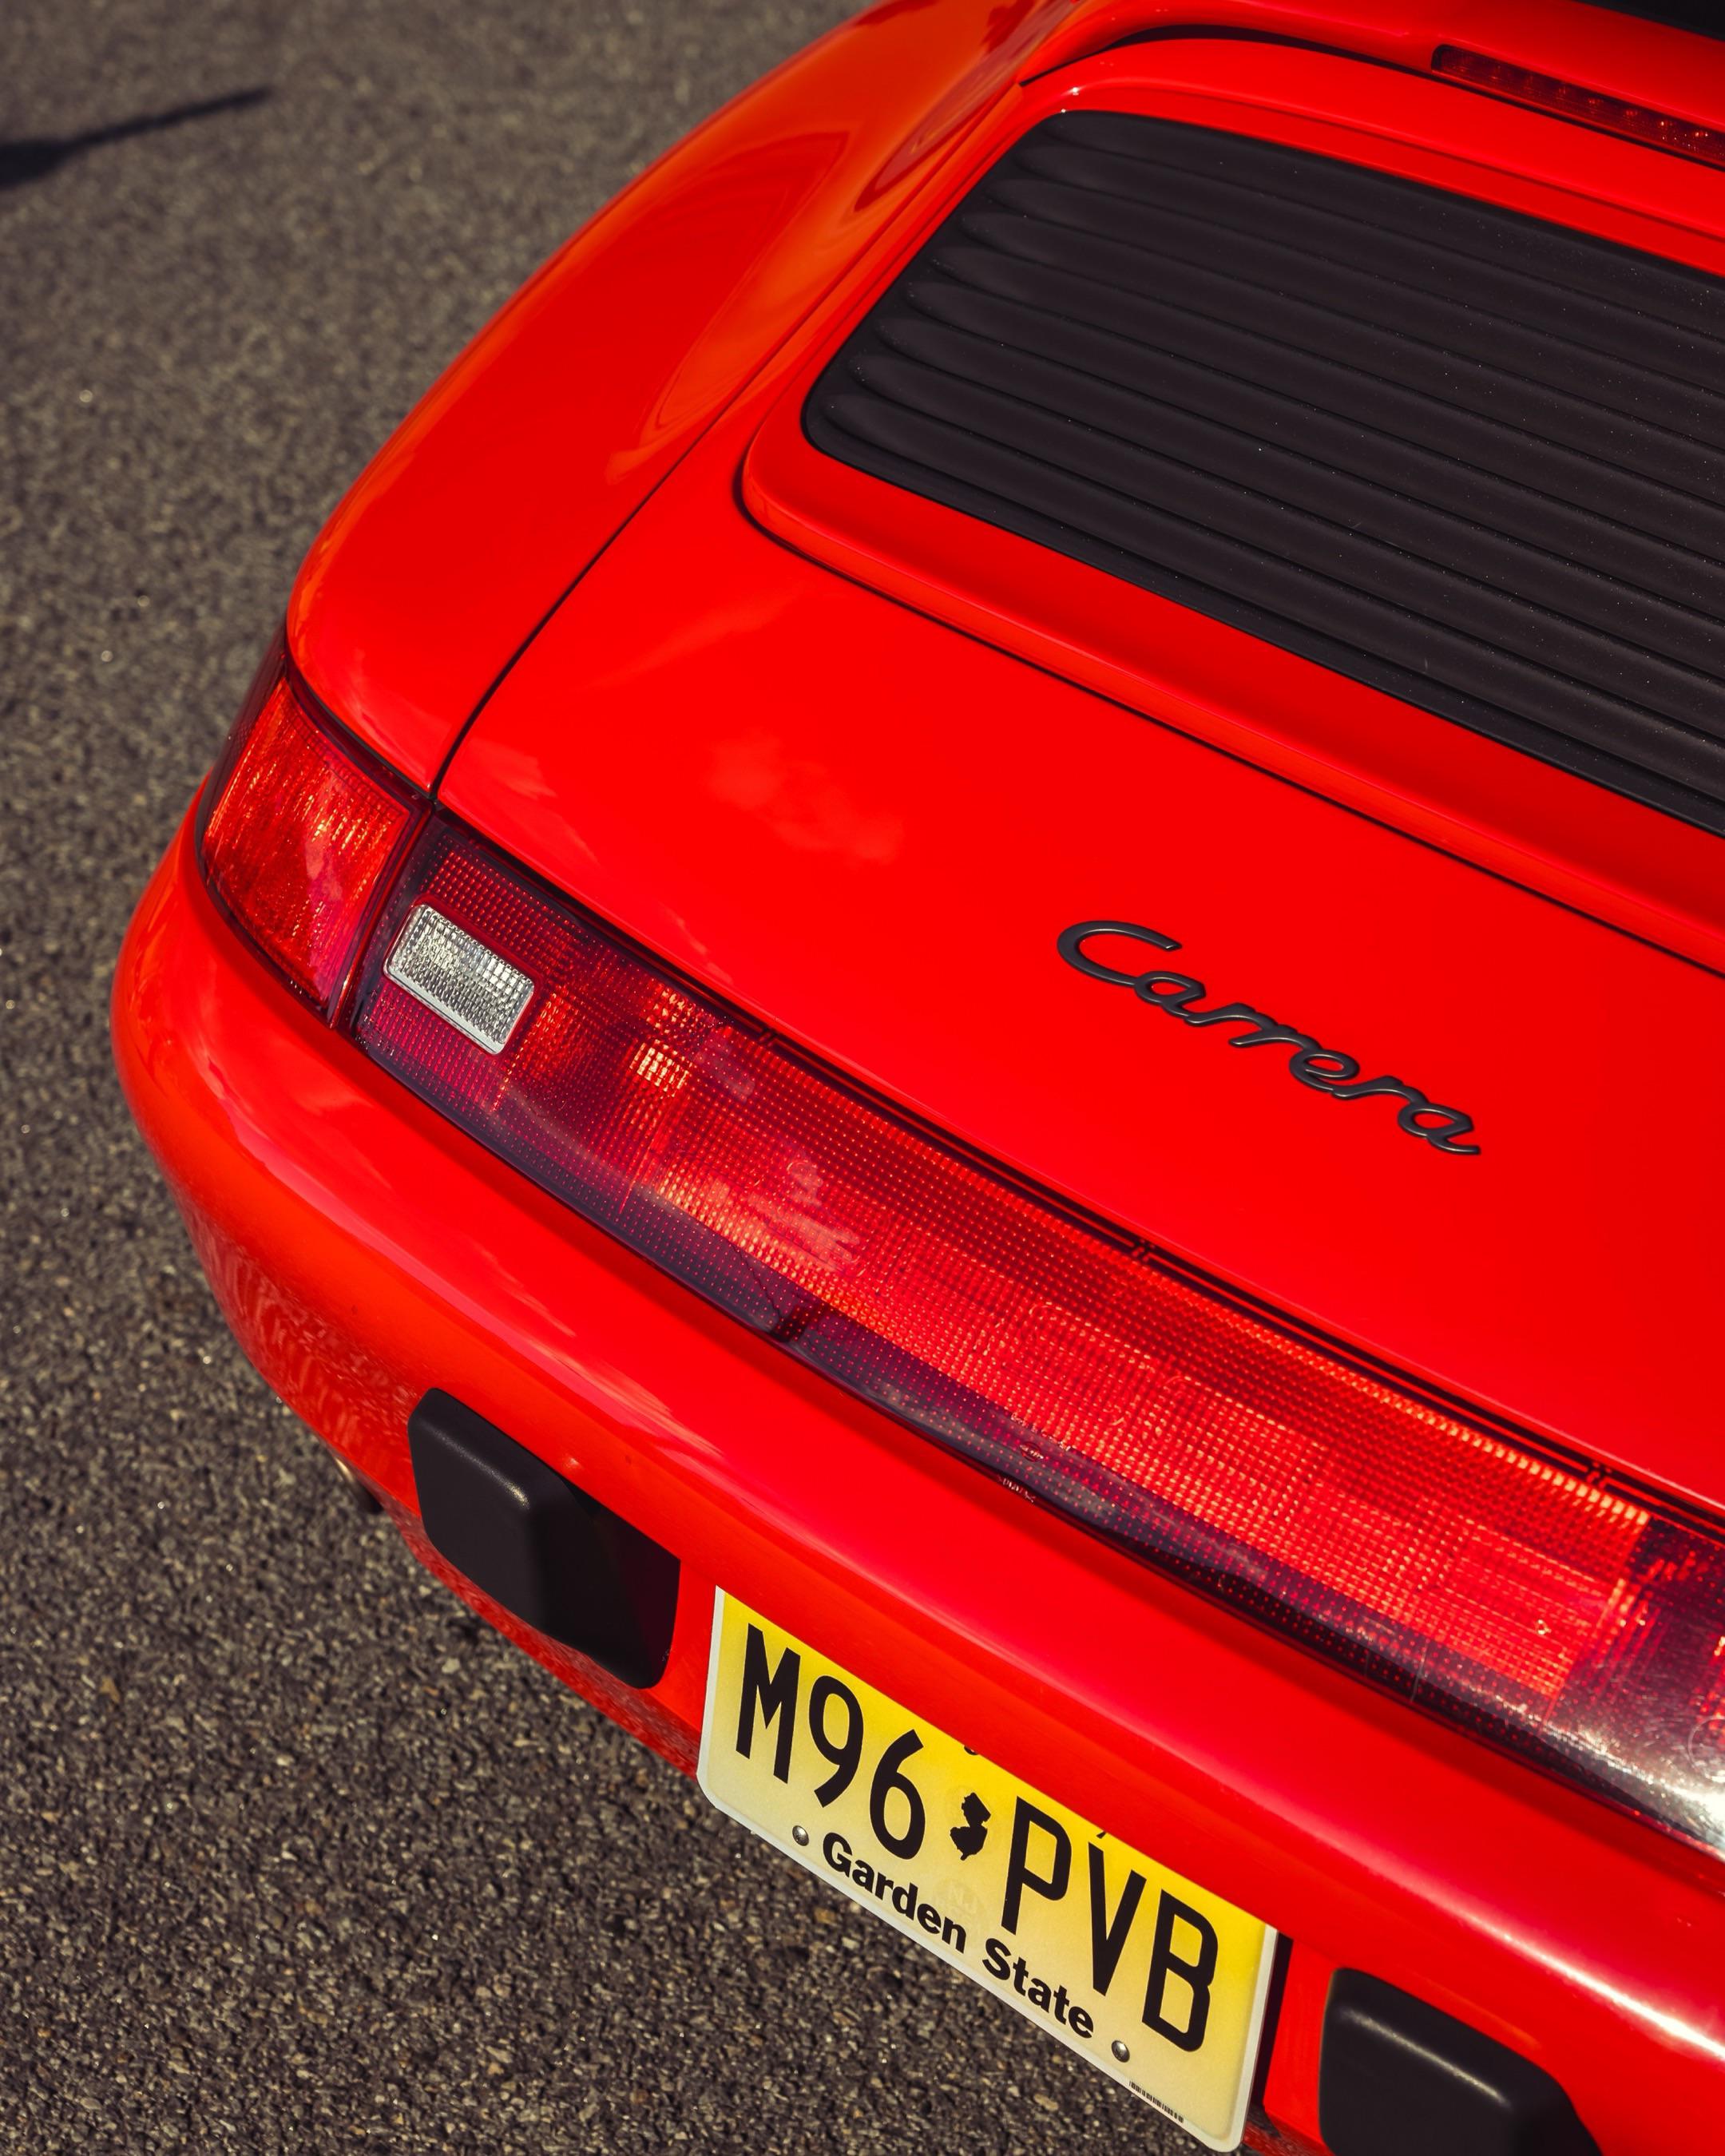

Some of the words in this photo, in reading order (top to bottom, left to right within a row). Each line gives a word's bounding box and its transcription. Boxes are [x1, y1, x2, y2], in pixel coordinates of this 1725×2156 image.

[1056, 920, 1481, 1155] Carrera
[736, 1623, 926, 1860] M96
[1001, 1796, 1219, 2052] PVB
[823, 1832, 967, 1954] Garden
[981, 1938, 1094, 2039] State
